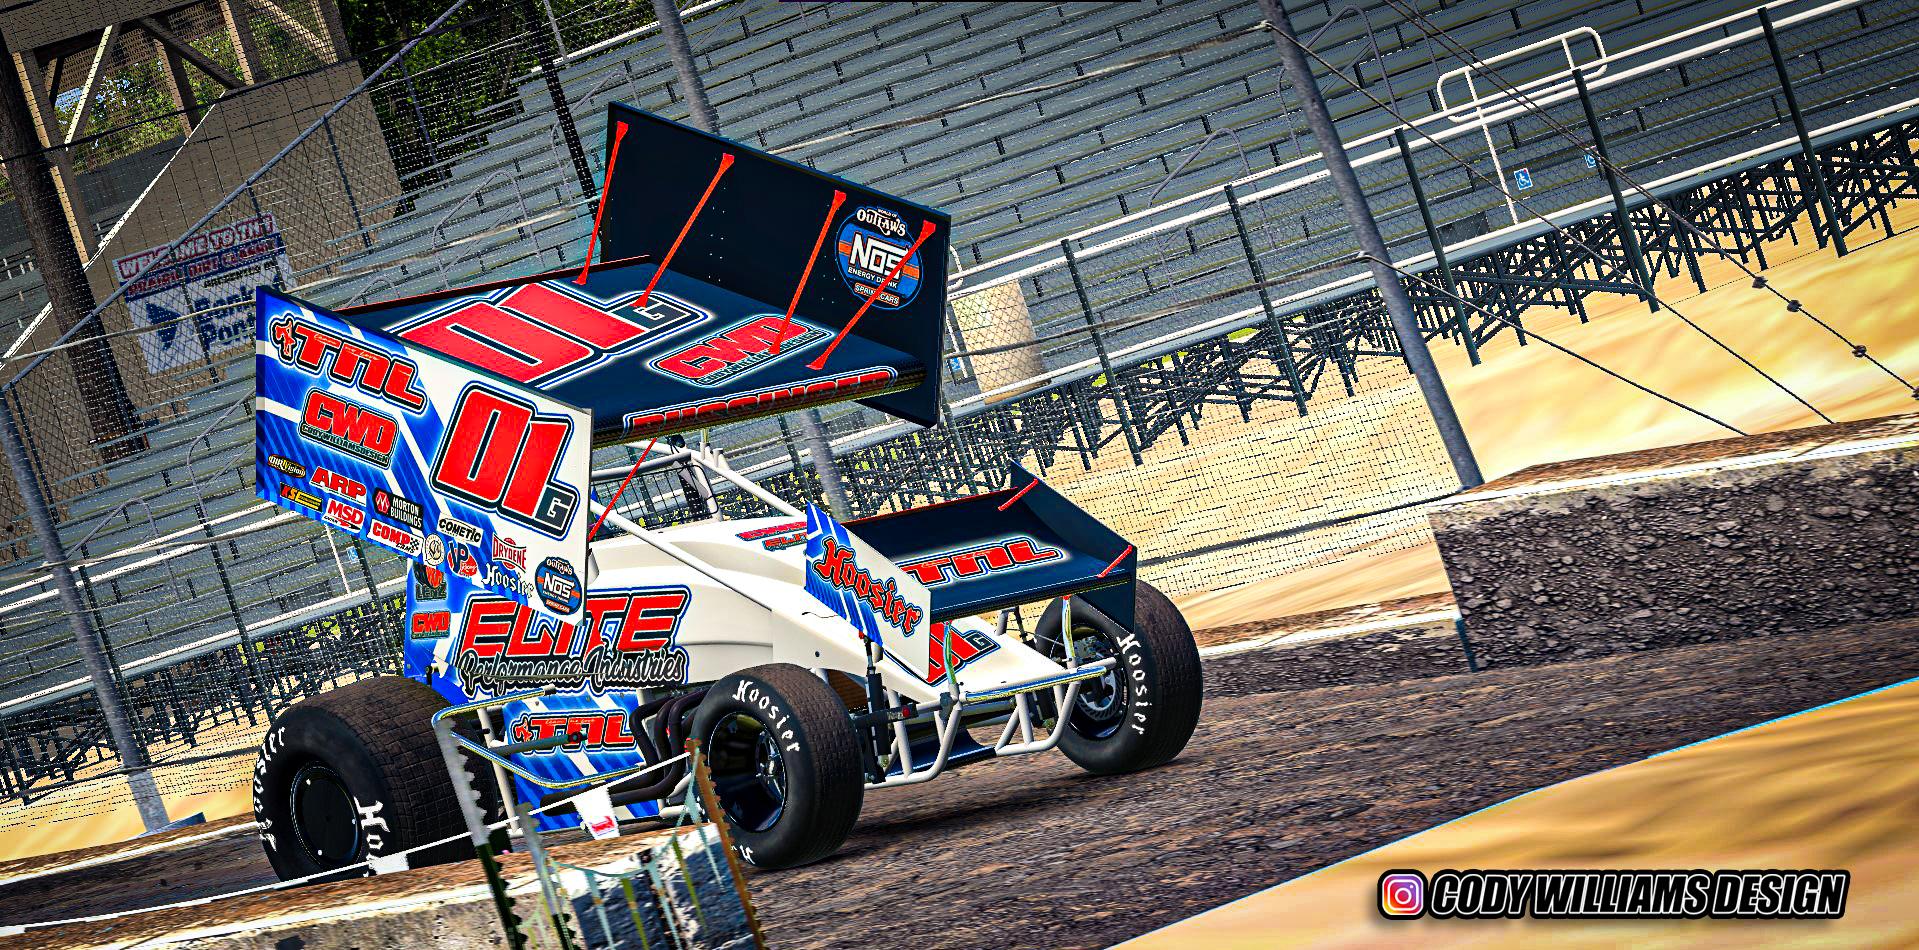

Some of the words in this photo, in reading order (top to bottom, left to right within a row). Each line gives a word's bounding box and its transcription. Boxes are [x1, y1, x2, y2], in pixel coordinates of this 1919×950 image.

[849, 232, 910, 280] NOS
[848, 266, 875, 281] ENERGY
[876, 276, 898, 289] DRNK
[658, 316, 809, 379] CWD
[305, 391, 397, 455] CWD
[311, 466, 367, 500] ARP
[327, 499, 364, 526] MSD
[390, 510, 422, 528] BUILDINGS
[392, 497, 420, 516] MORTON
[372, 522, 411, 545] COMP
[438, 518, 482, 543] COMETIC
[448, 542, 469, 575] VP
[493, 537, 527, 569] DRYDENE
[481, 563, 535, 598] Hoosier
[543, 572, 576, 597] NOS
[815, 540, 922, 634] Hoosier
[412, 612, 450, 633] CWD
[461, 593, 687, 659] ELITE
[456, 650, 584, 697] Performance
[583, 646, 684, 690] Industries
[1116, 633, 1152, 735] Hoosier
[732, 679, 801, 752] Hoosier
